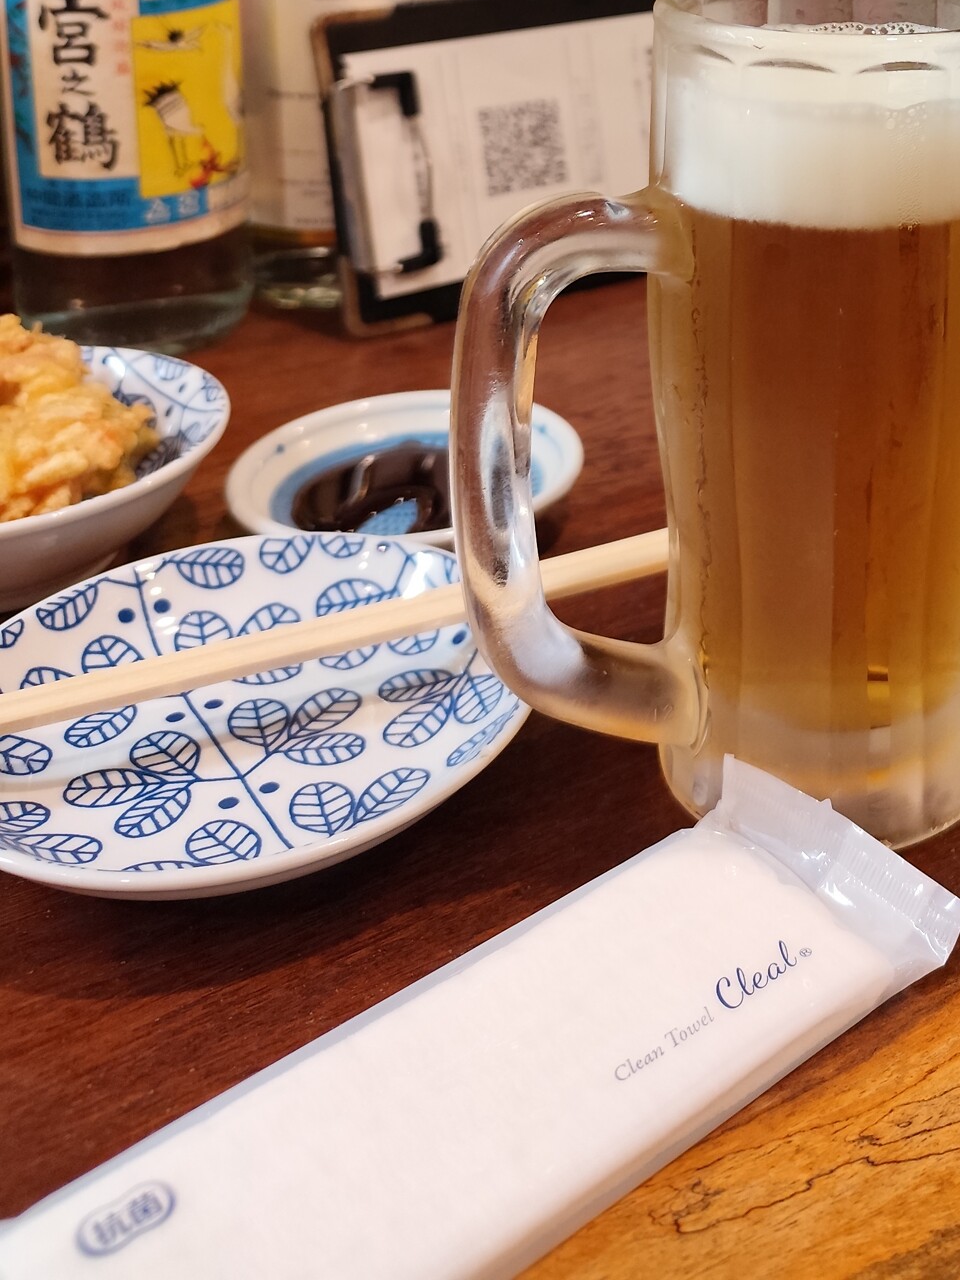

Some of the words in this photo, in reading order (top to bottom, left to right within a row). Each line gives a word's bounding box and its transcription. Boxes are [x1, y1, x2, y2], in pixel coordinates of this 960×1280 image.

[614, 1045, 665, 1081] Clean
[664, 1006, 715, 1047] Towel
[93, 1190, 163, 1246] 抗菌
